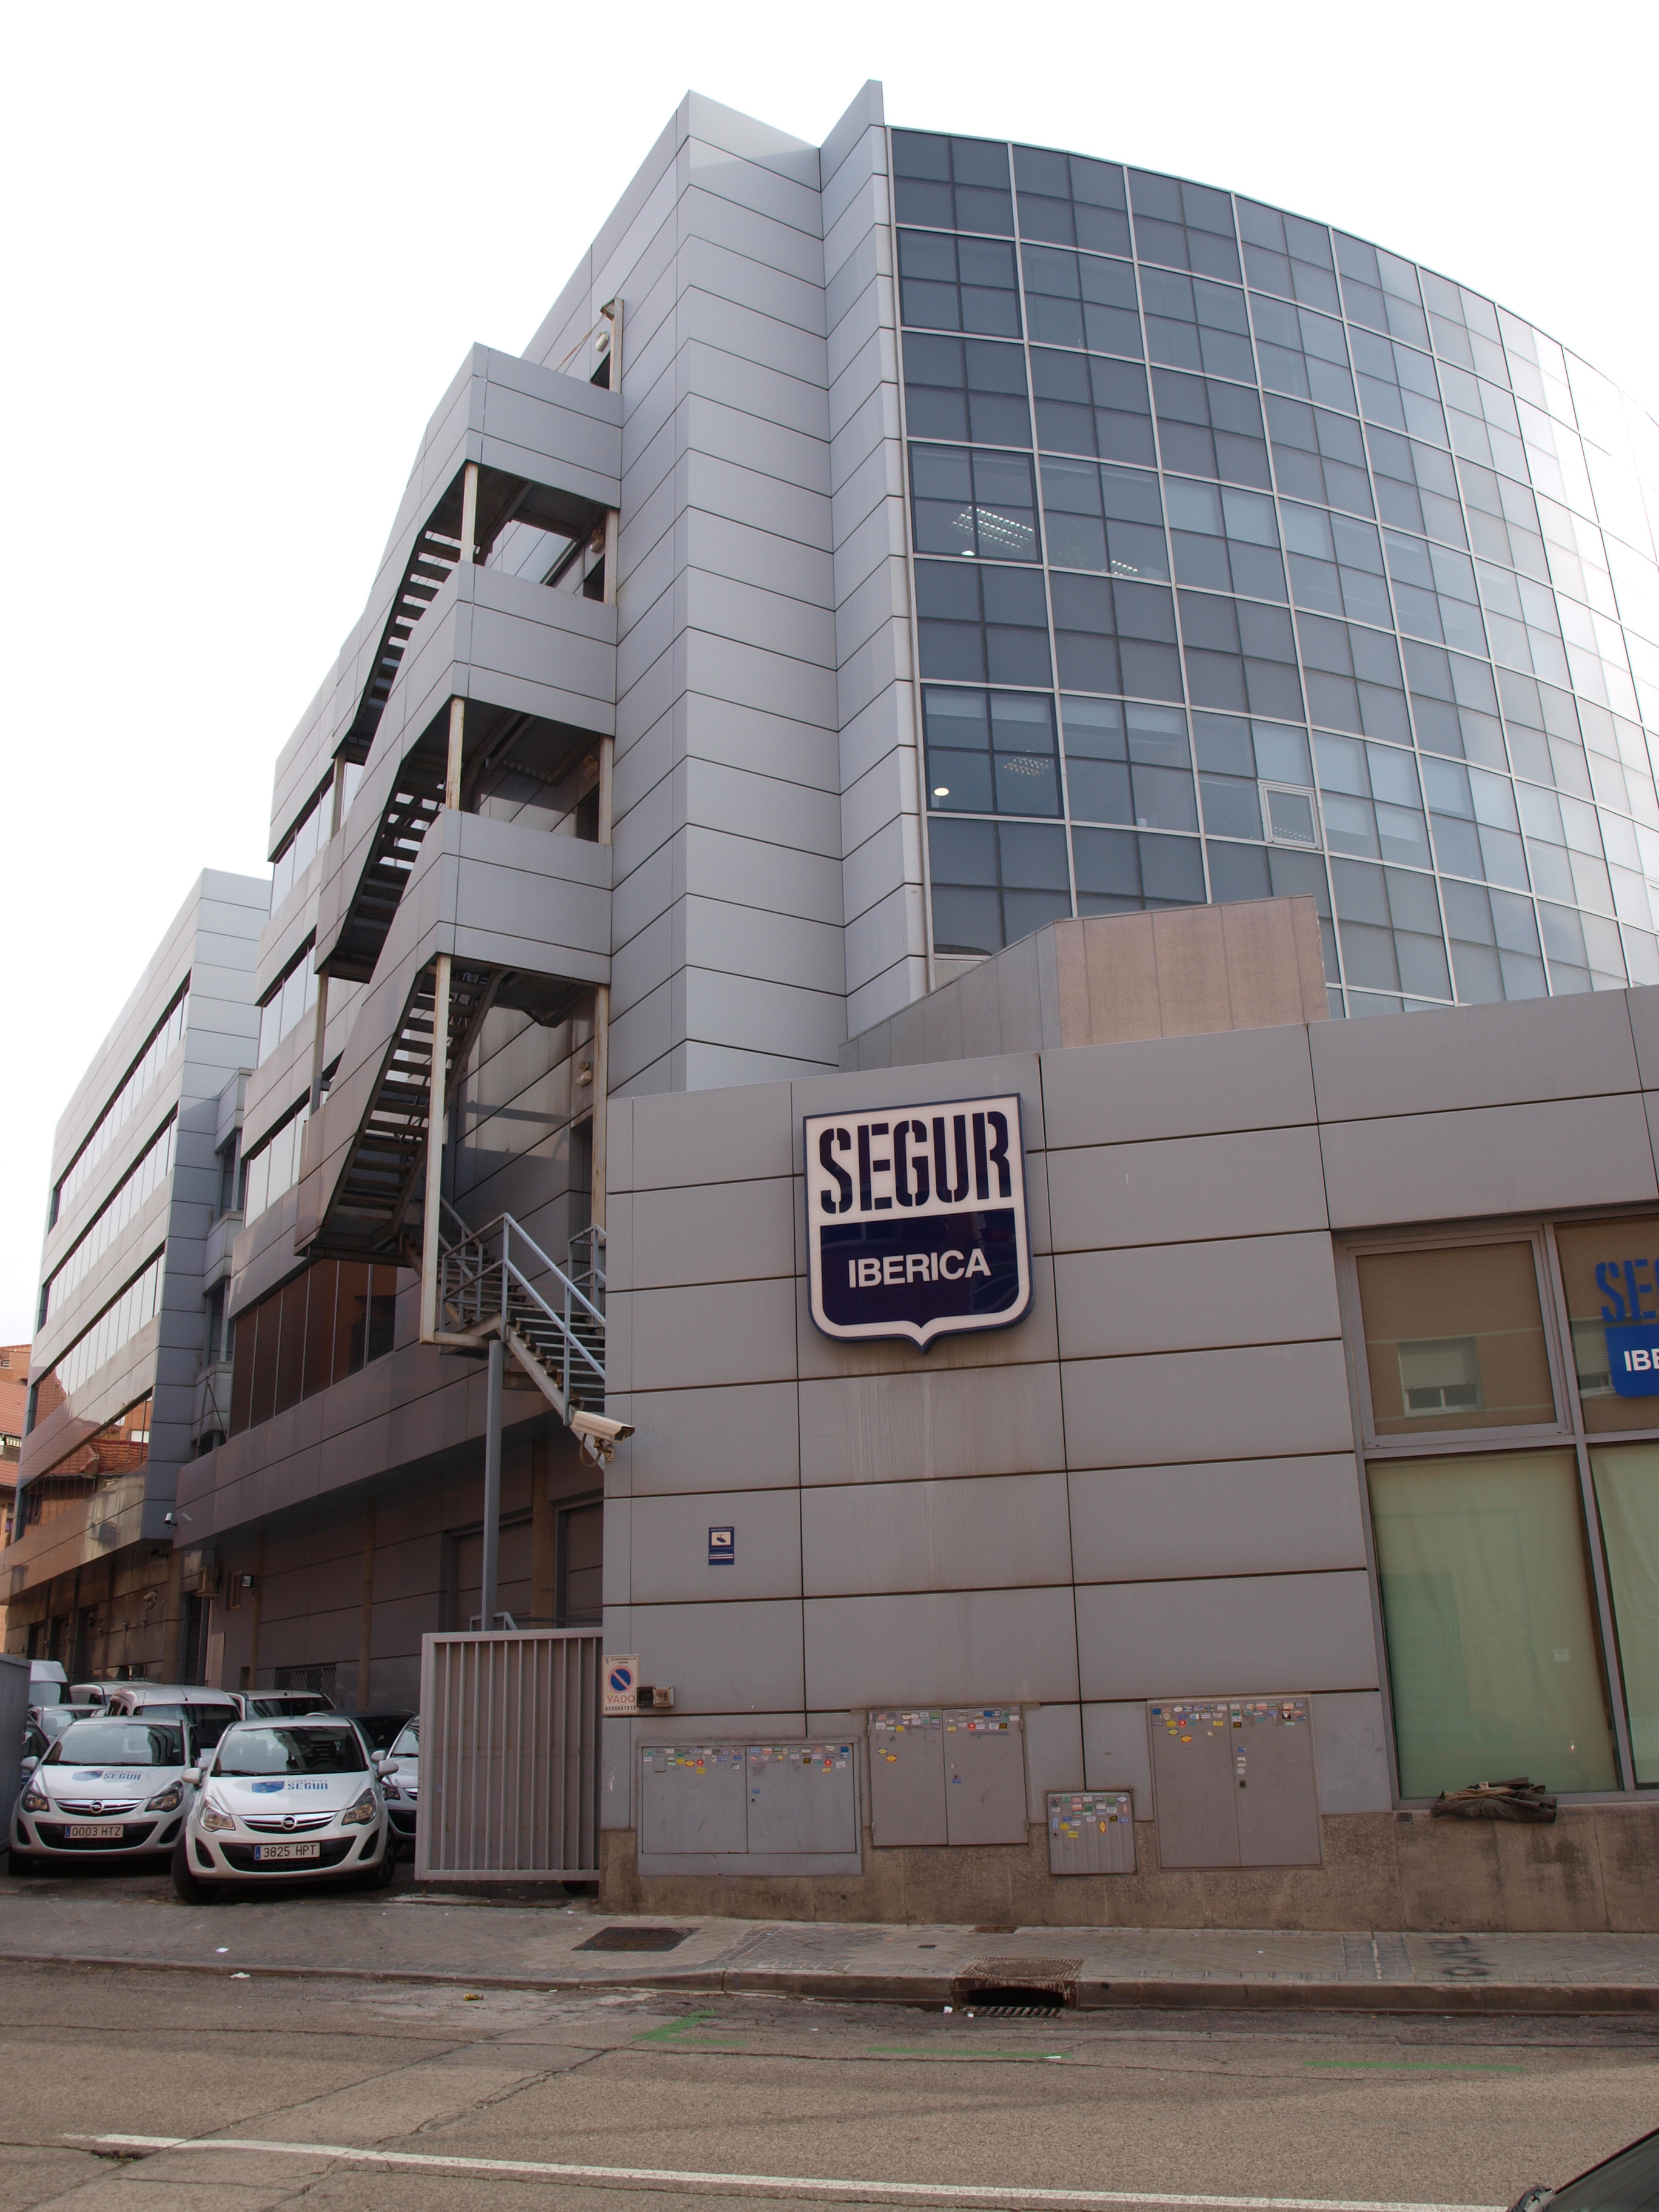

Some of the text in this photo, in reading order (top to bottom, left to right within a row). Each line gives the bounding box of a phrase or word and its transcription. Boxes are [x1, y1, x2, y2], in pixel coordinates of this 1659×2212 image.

[819, 1111, 1011, 1215] SEGUR
[848, 1248, 991, 1289] IBERICA
[1595, 1258, 1659, 1323] SE
[606, 1695, 635, 1703] VADO
[72, 1826, 121, 1837] 0003 HTZ
[263, 1845, 317, 1857] 3825 HPT
